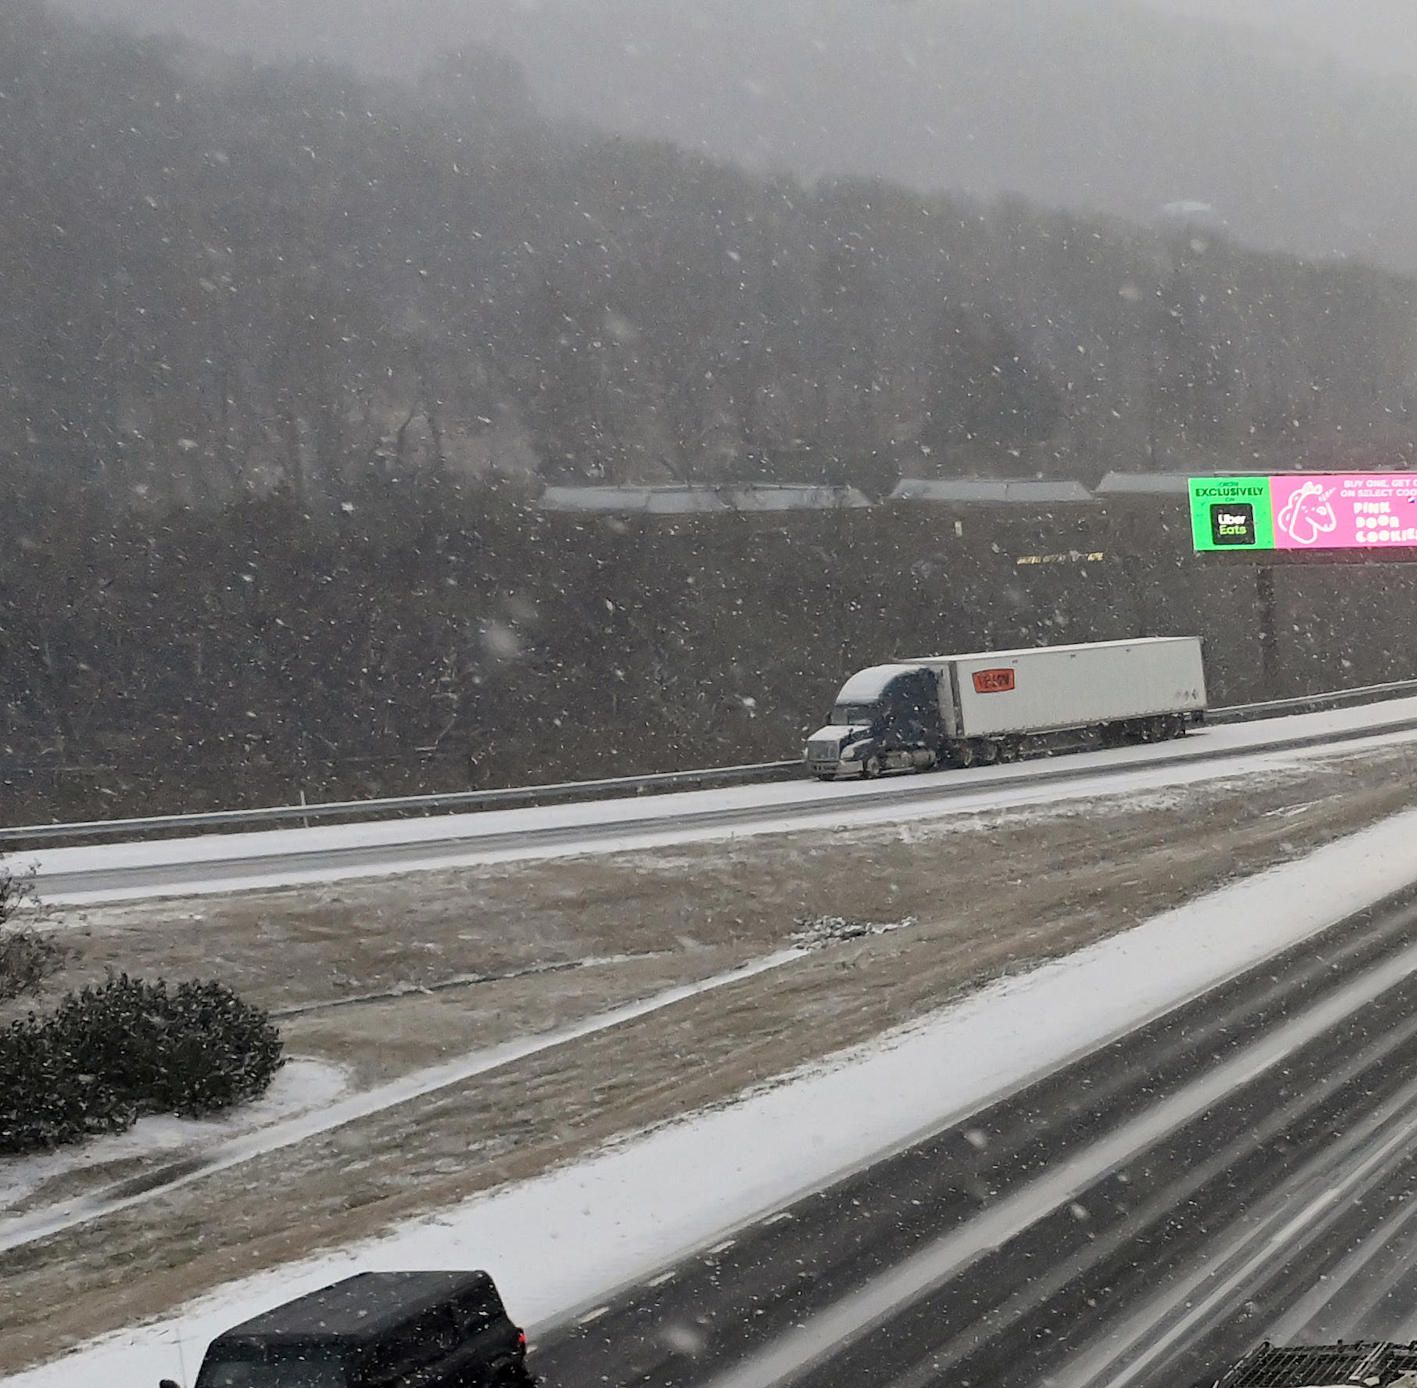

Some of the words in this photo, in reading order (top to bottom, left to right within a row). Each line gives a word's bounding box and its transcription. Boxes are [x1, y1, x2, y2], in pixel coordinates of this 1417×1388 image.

[1344, 480, 1363, 488] BUY
[1391, 479, 1411, 487] GET
[1195, 487, 1264, 497] EXCLUSIVELY
[1340, 489, 1355, 497] ON
[1357, 488, 1394, 497] SELECT
[1353, 502, 1391, 514] PINK
[1217, 513, 1246, 525] Uber
[1355, 514, 1400, 528] DOOR
[1219, 525, 1247, 535] Eats
